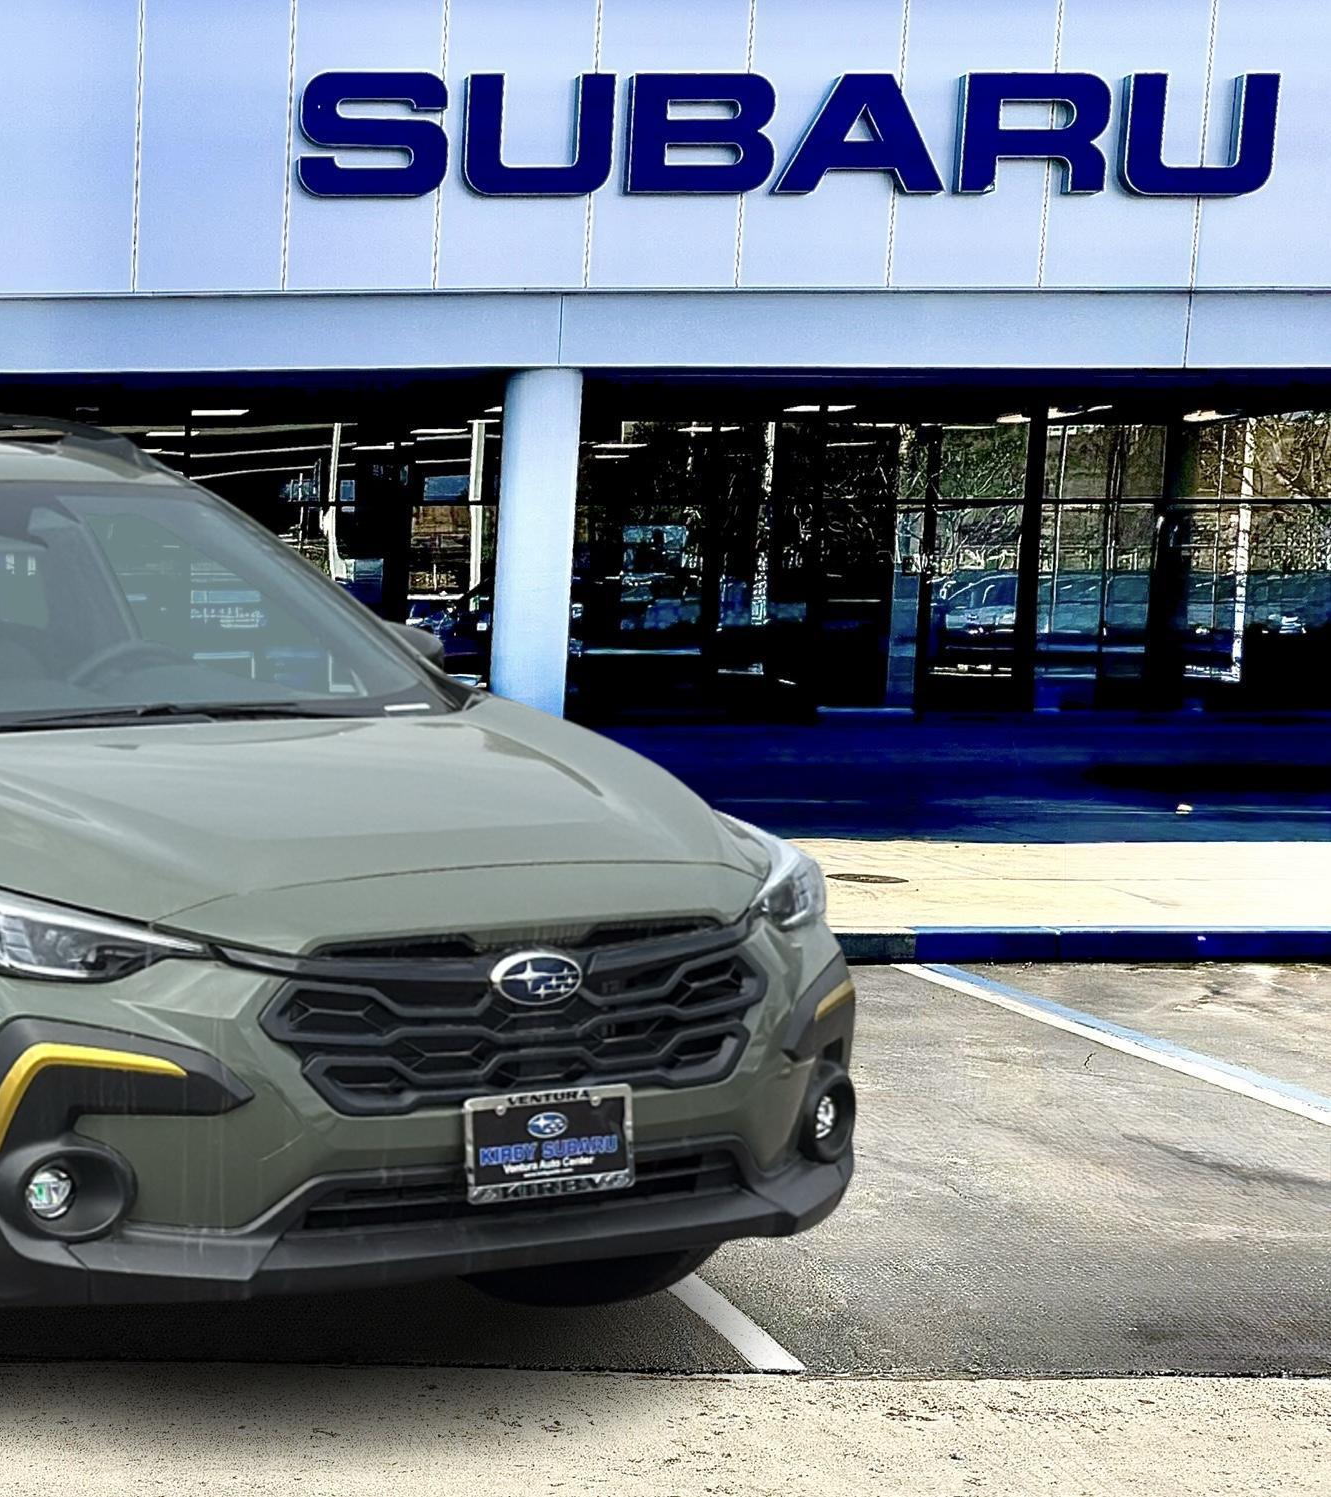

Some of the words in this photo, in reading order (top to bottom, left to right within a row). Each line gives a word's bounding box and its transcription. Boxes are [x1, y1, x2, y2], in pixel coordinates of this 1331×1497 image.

[297, 70, 1281, 197] SUBARU
[507, 1090, 590, 1106] VENTURA
[480, 1143, 537, 1166] KIRBY
[542, 1136, 618, 1158] SUBARU
[502, 1162, 538, 1175] Ventura
[539, 1159, 561, 1169] Auto
[562, 1156, 595, 1167] Center
